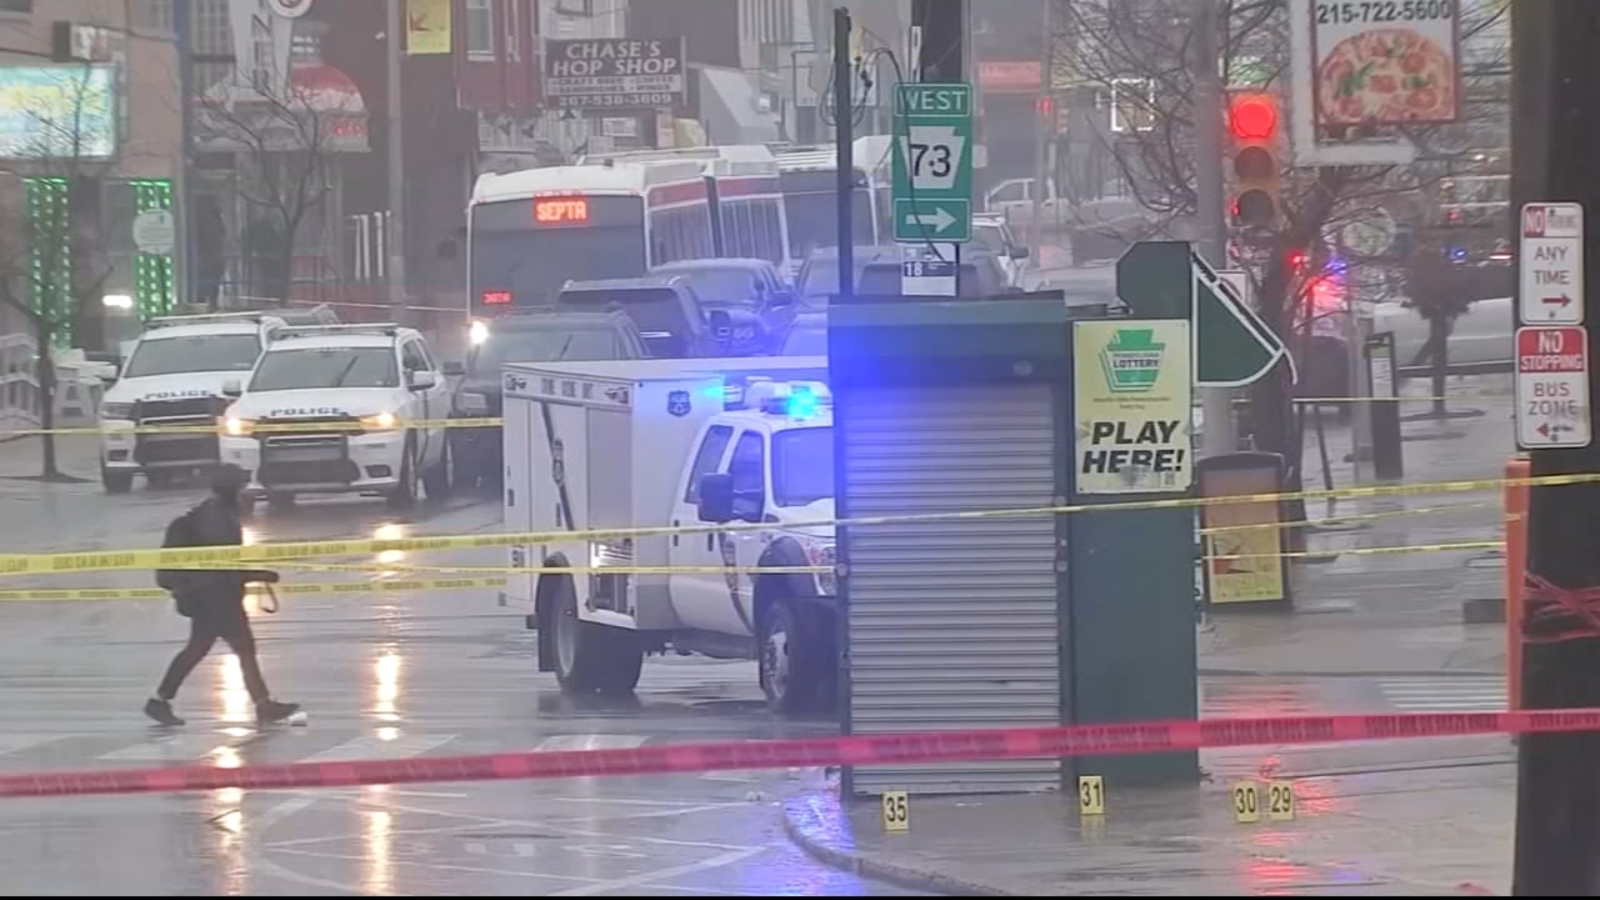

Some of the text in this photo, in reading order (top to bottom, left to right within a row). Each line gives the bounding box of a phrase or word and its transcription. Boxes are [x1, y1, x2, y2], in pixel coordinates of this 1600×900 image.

[1317, 0, 1451, 24] 215-722-5600
[565, 40, 661, 59] CHASE'S
[553, 58, 677, 76] HOP SHOP
[900, 90, 966, 110] WEST
[909, 143, 952, 178] 73
[536, 200, 587, 221] SEPTA
[1525, 209, 1545, 233] NO
[1534, 245, 1570, 261] ANY
[906, 262, 924, 276] 18
[1533, 268, 1571, 286] TIME
[1538, 330, 1564, 353] NO
[1112, 358, 1161, 369] LOTTERY
[1520, 354, 1584, 371] STOPPING
[144, 389, 214, 400] POLICE
[1534, 381, 1571, 397] BUS
[270, 406, 345, 417] POLICE
[1529, 399, 1578, 416] ZONE
[1091, 419, 1181, 446] PLAY
[1080, 781, 1101, 807] 31
[1234, 785, 1291, 814] 30 29
[885, 796, 907, 823] 35
